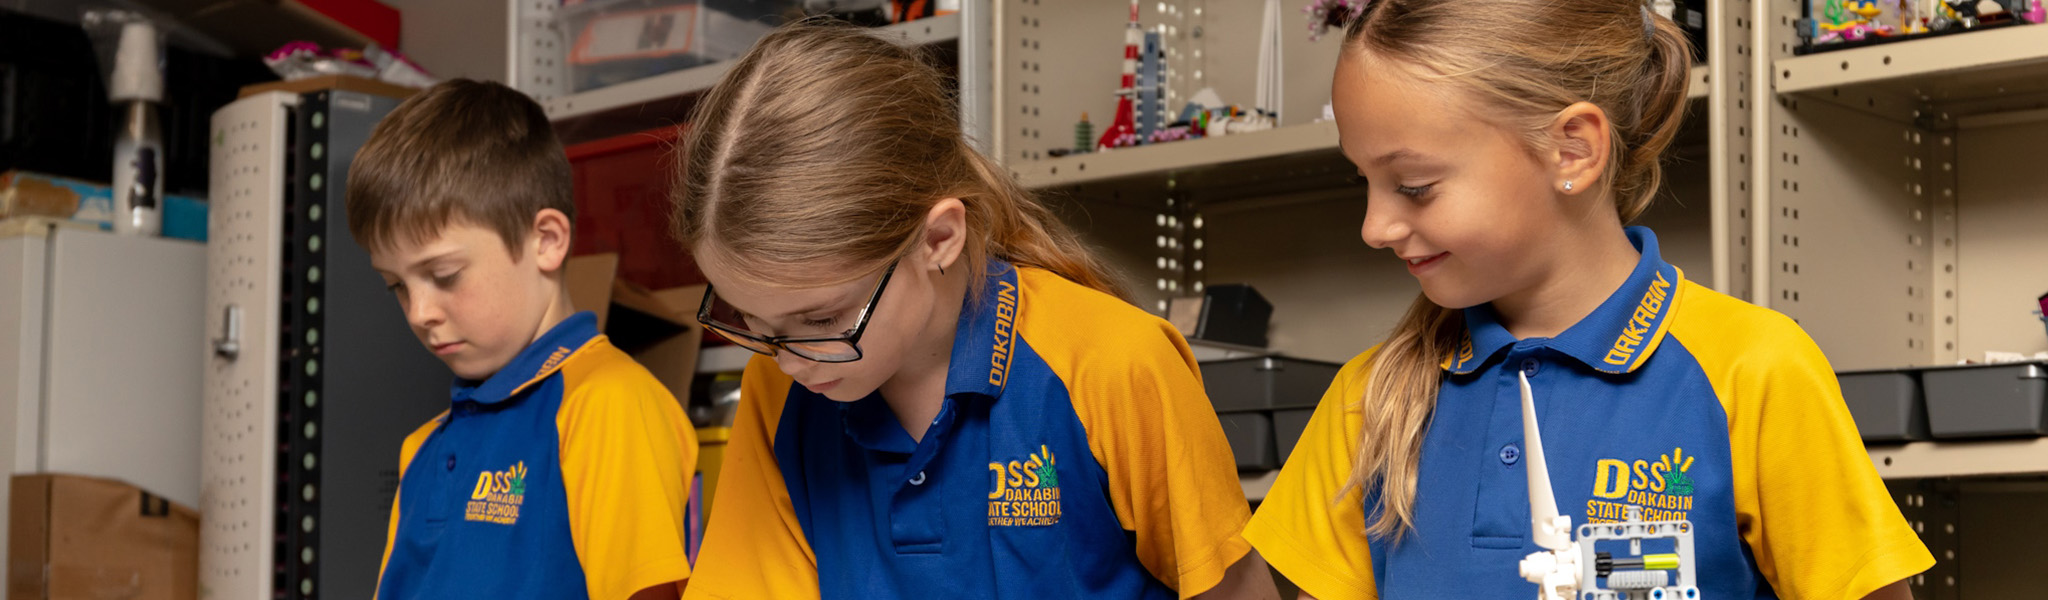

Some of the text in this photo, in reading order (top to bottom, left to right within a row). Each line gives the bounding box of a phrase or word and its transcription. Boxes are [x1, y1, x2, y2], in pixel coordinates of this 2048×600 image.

[1603, 270, 1671, 365] DAKABIN
[989, 280, 1016, 387] DAKABIN
[471, 470, 511, 500] DSS
[1593, 459, 1666, 499] DSS
[988, 501, 1010, 517] ATE
[1586, 499, 1630, 520] STATE
[1627, 489, 1693, 510] DAKABIN
